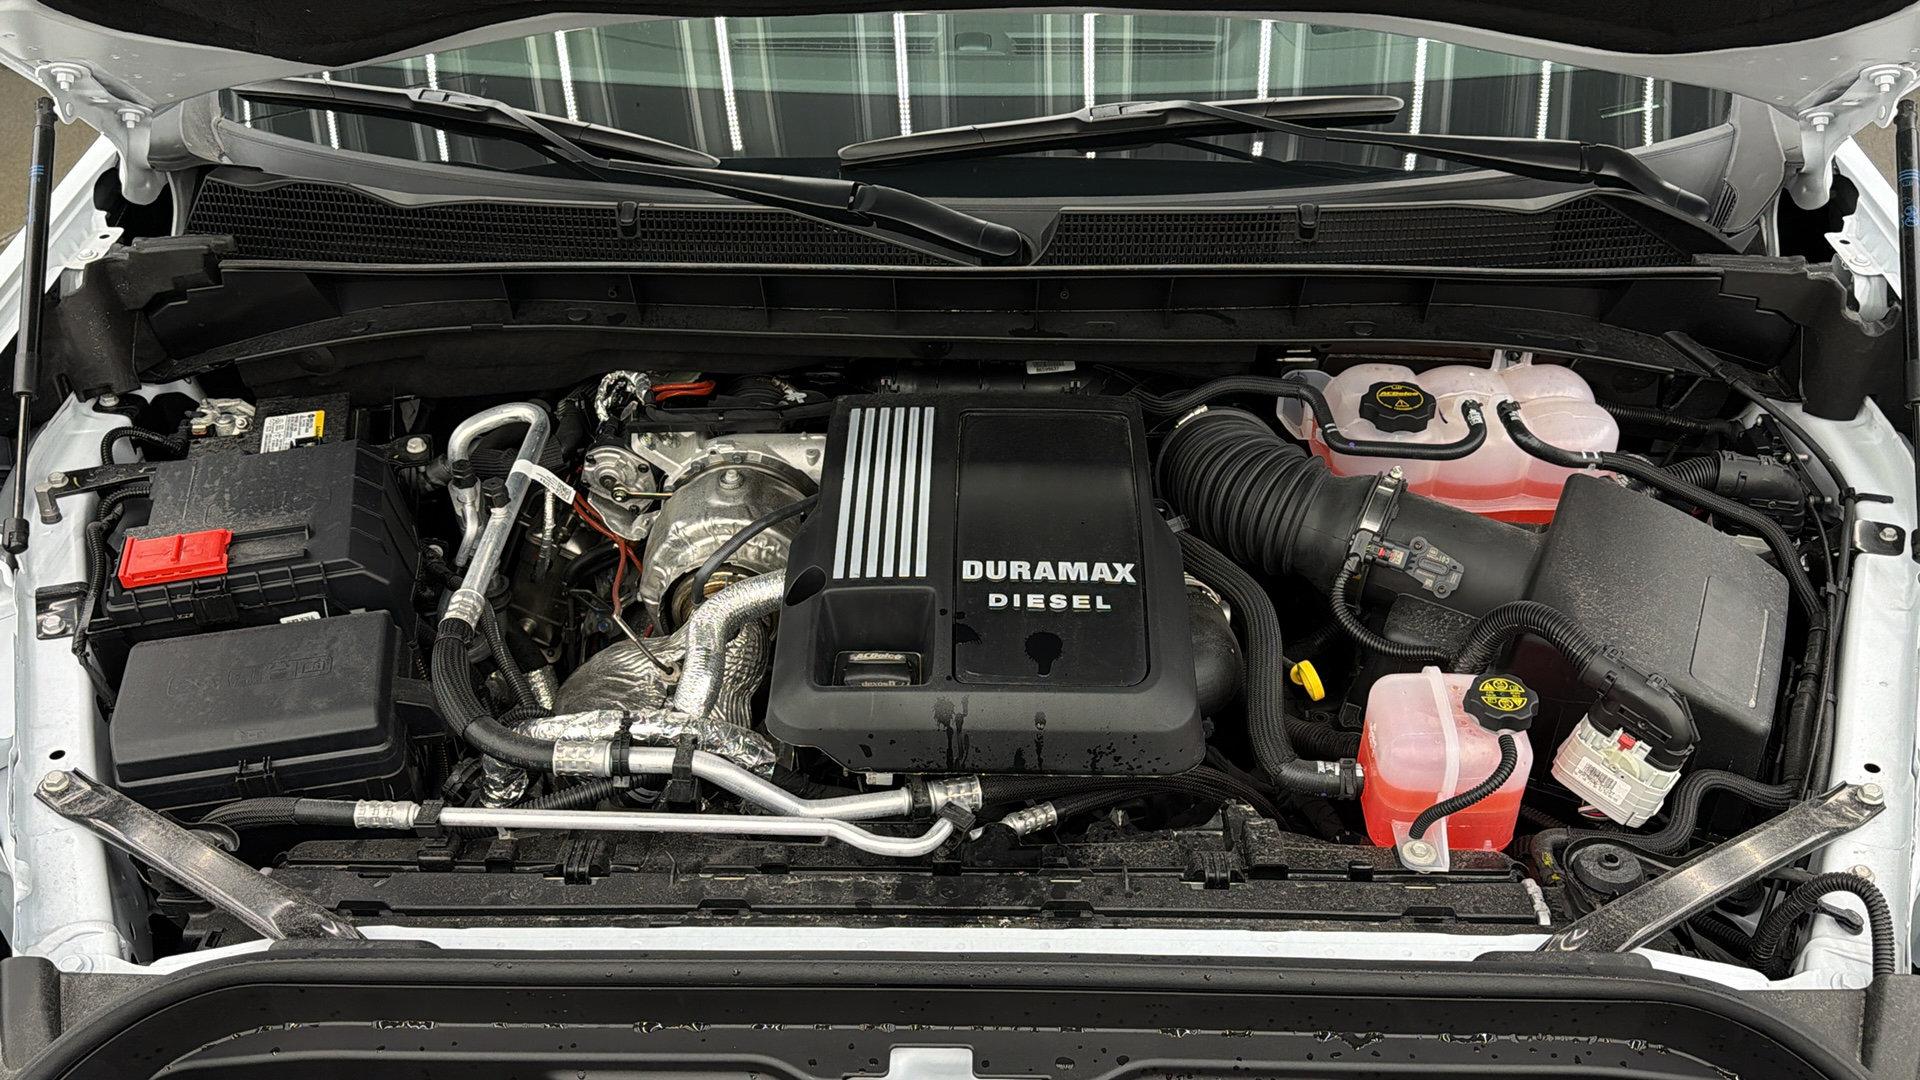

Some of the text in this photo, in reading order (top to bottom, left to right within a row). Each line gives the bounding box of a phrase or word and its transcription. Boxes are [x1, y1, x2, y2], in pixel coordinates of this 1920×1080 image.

[962, 560, 1136, 585] DURAMAX
[988, 593, 1112, 612] DIESEL
[854, 652, 903, 661] ACDelco
